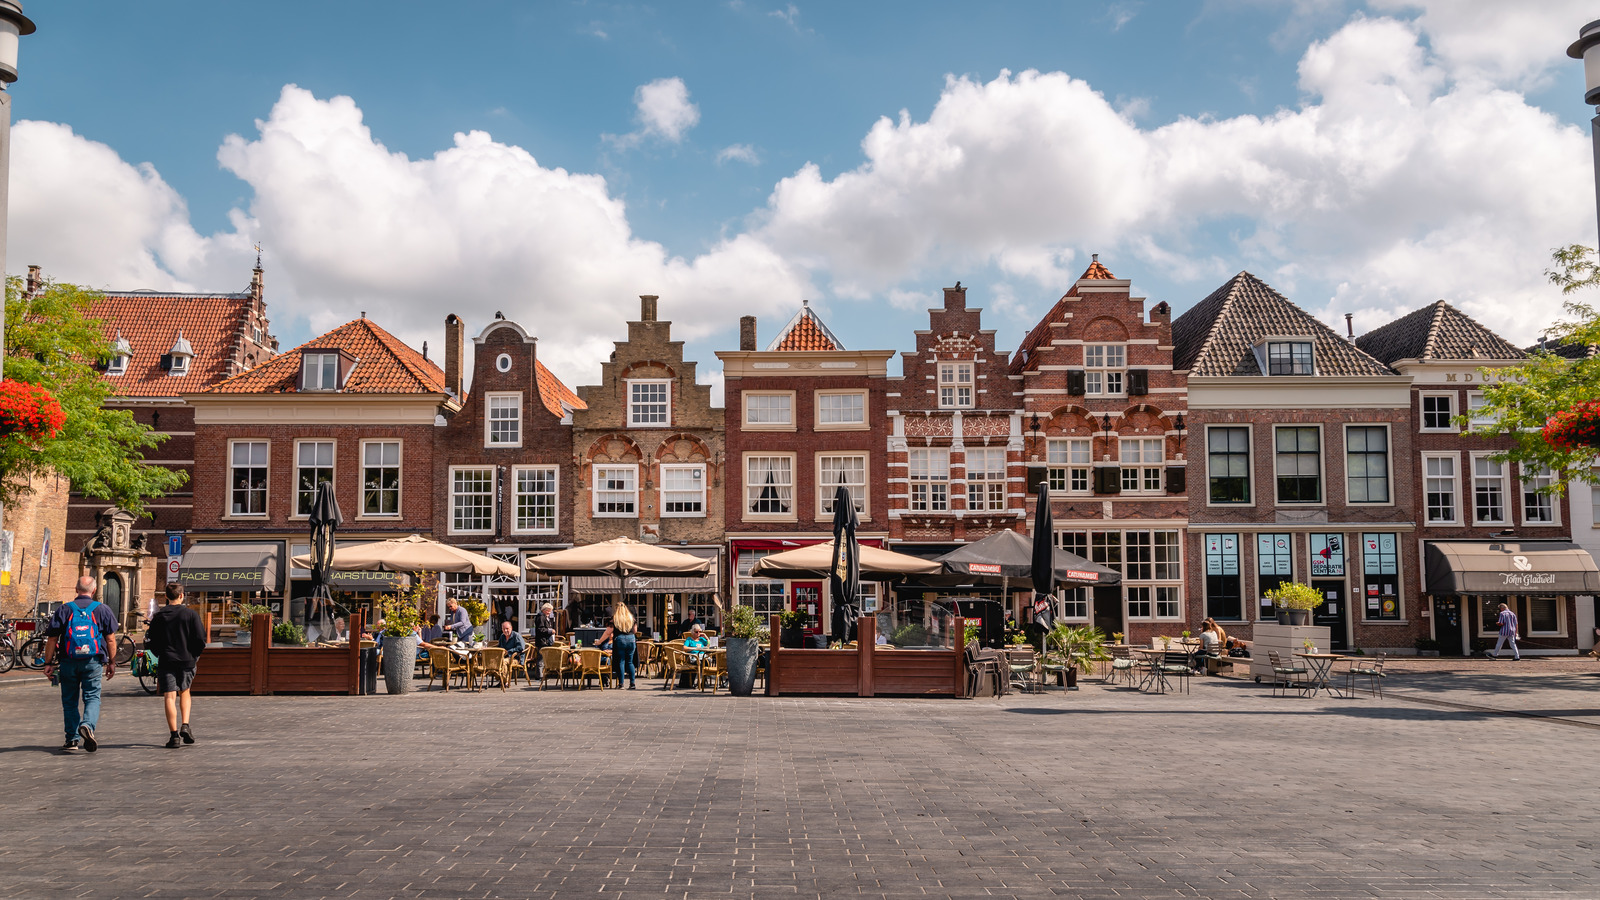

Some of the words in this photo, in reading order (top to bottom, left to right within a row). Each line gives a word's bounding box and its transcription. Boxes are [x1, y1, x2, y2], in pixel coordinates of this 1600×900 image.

[232, 572, 262, 580] FACE
[1499, 573, 1522, 586] John
[1521, 573, 1556, 586] Gladwell
